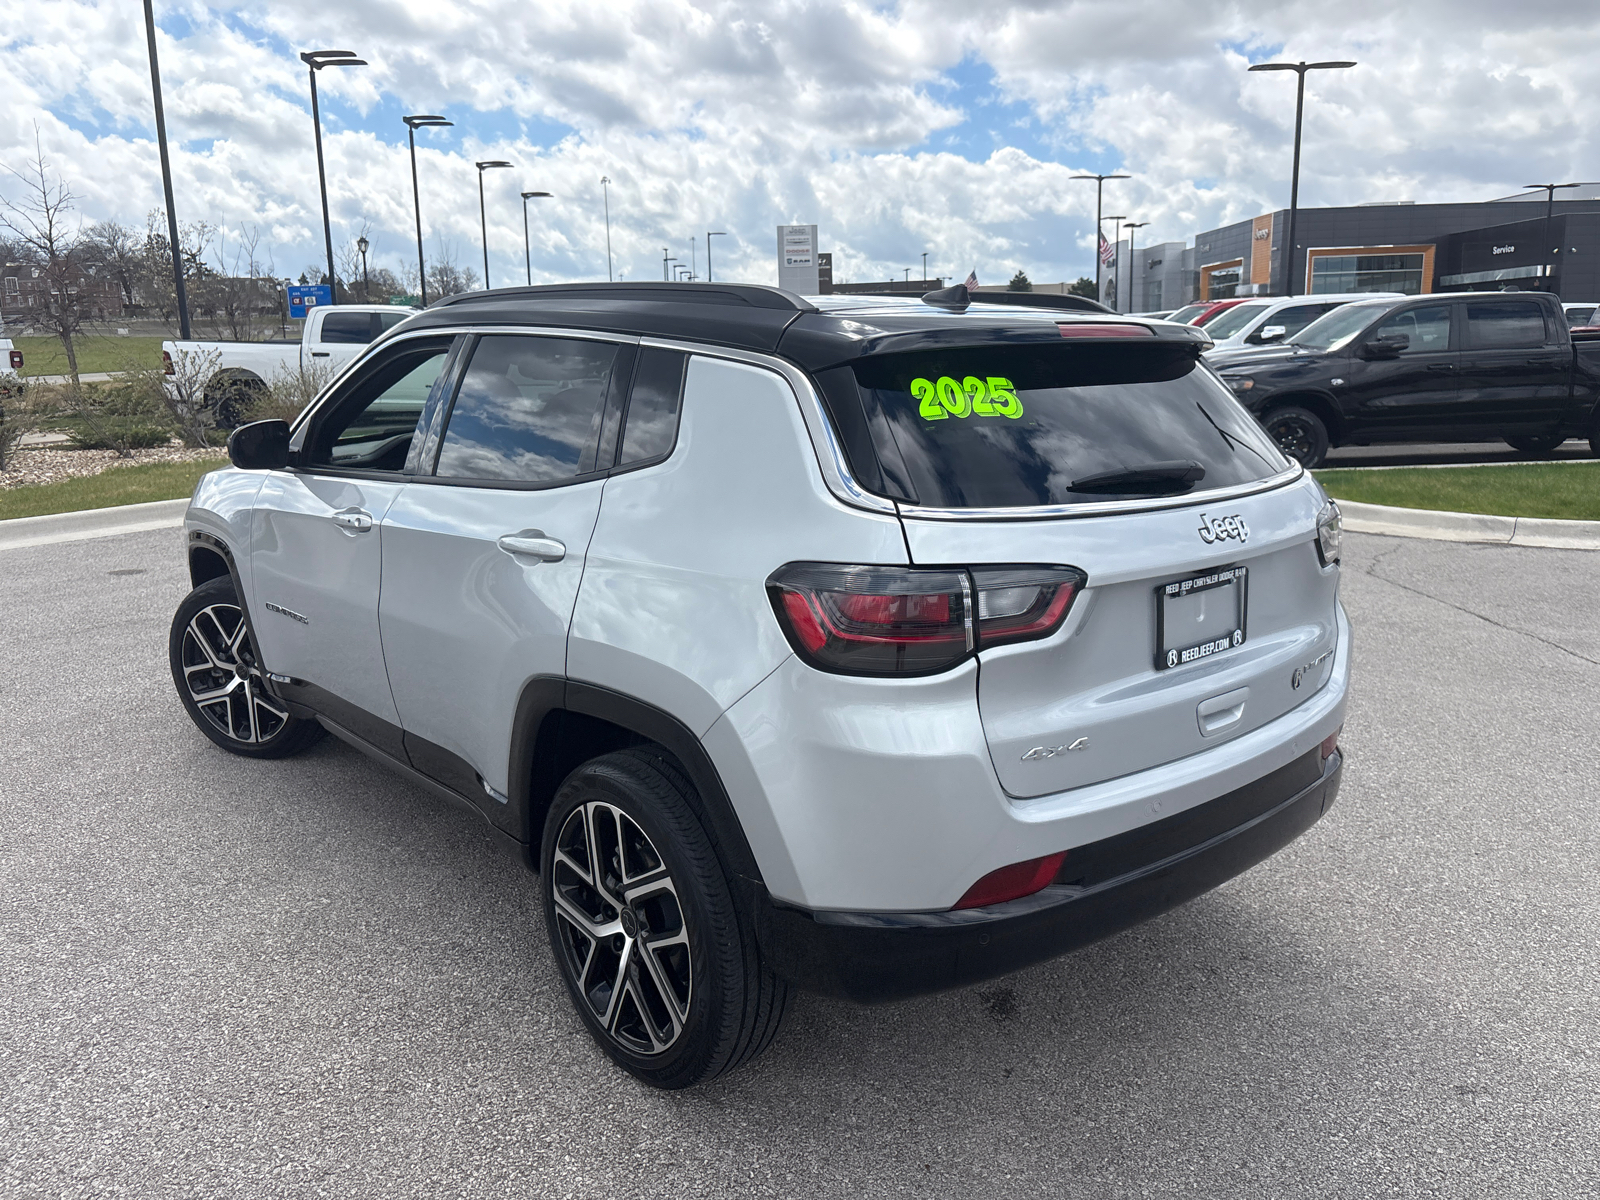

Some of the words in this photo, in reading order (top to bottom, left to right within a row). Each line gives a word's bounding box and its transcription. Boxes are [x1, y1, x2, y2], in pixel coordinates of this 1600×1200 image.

[1492, 245, 1515, 255] Service
[910, 376, 1024, 420] 2025
[1198, 513, 1250, 544] Jeep
[1165, 583, 1180, 594] REED
[1180, 580, 1193, 591] JEEP
[1193, 574, 1218, 588] CHRYSLER
[1219, 569, 1235, 581] DODGE
[1235, 567, 1246, 577] RAM
[1181, 637, 1230, 663] REEDJEEP.COM
